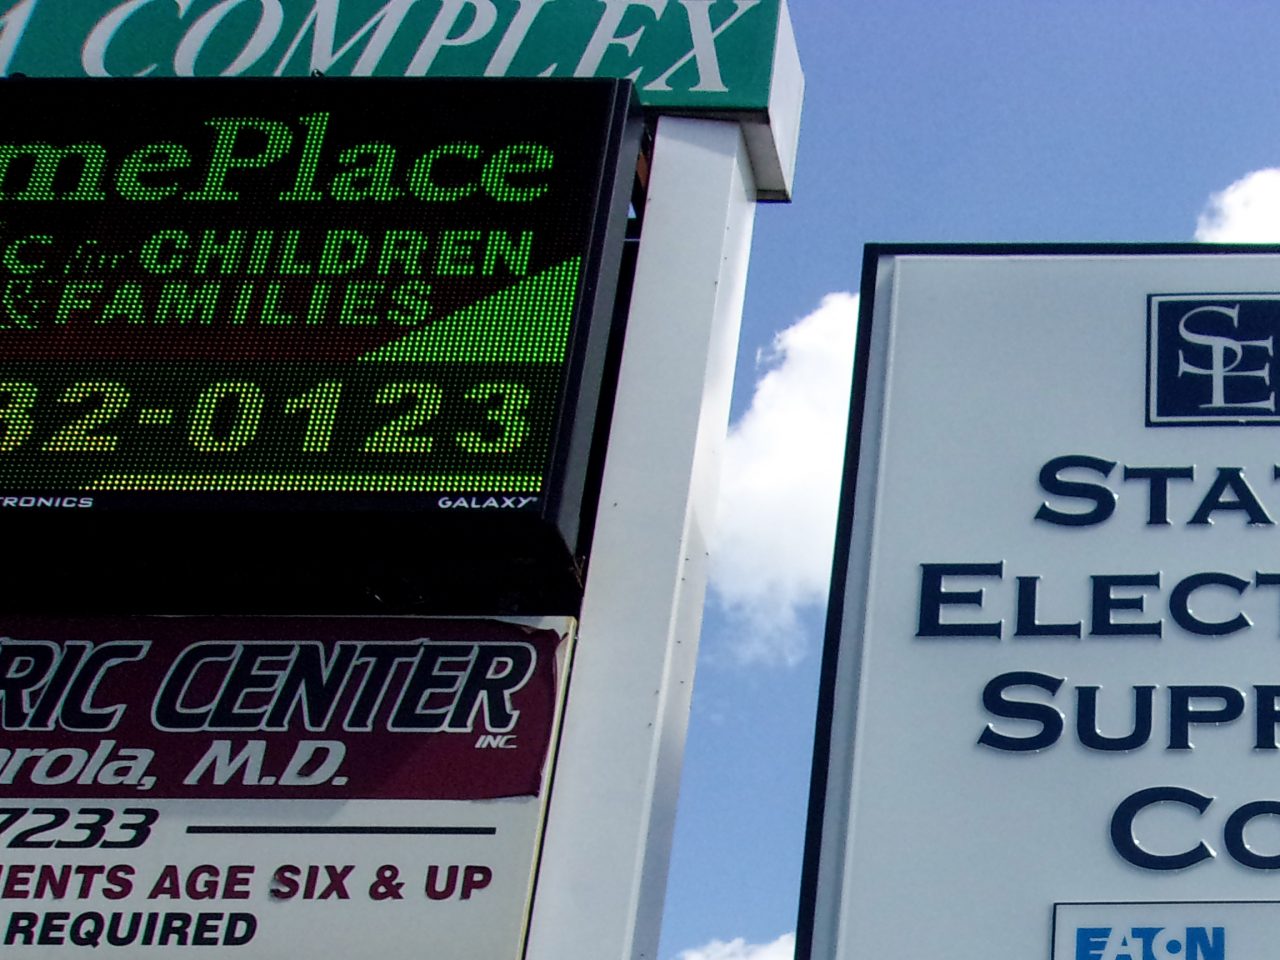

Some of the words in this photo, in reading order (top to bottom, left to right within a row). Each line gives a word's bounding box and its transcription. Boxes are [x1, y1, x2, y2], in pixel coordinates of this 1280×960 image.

[82, 0, 761, 92] COMPLEX
[139, 230, 533, 276] CHILDREN
[54, 279, 436, 324] FAMILIES
[151, 638, 536, 733] CENTER
[0, 739, 157, 790] rola,
[183, 740, 349, 786] M.D.
[0, 864, 136, 900] ENTS
[147, 864, 256, 900] AGE
[271, 864, 355, 900] SIX
[368, 865, 405, 899] &
[425, 865, 493, 899] UP
[3, 911, 257, 948] REQUIRED
